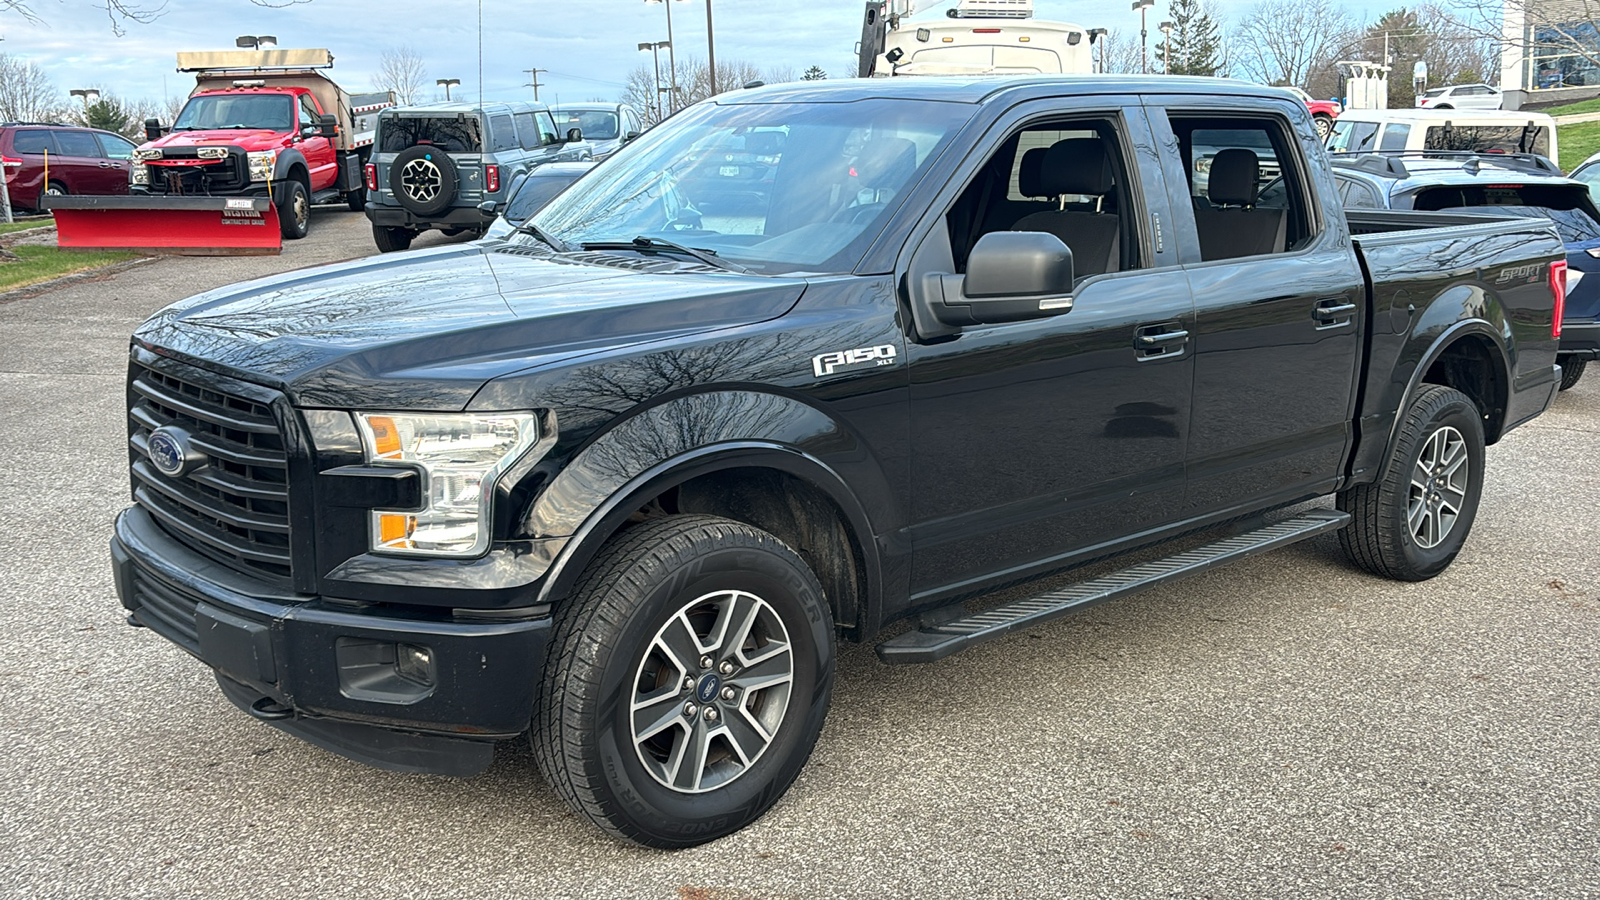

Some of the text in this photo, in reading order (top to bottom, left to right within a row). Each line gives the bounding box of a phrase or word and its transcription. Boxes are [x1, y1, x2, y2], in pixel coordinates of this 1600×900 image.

[1495, 262, 1546, 285] SPORT
[877, 358, 894, 366] XLT
[737, 553, 820, 625] COPER
[605, 755, 621, 787] PLUS
[620, 787, 728, 835] ENDEOR
